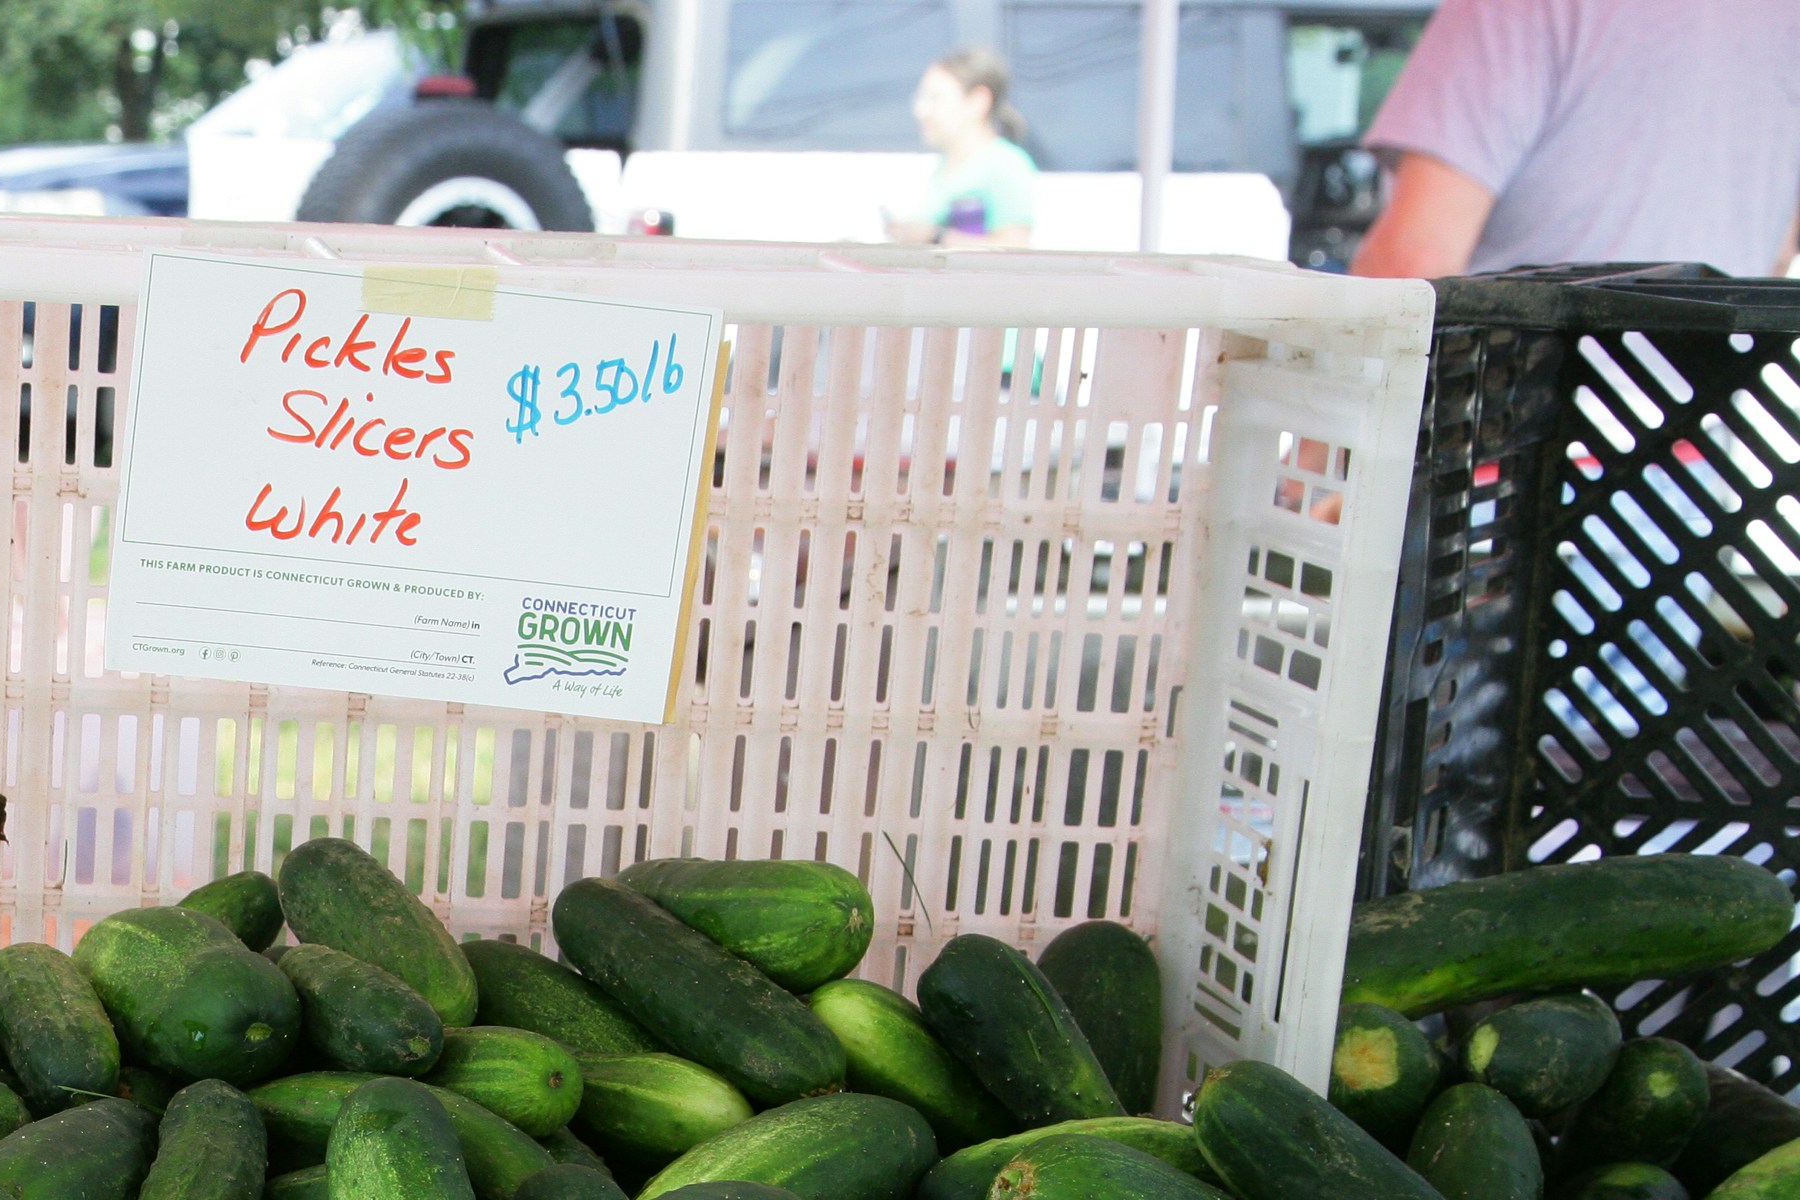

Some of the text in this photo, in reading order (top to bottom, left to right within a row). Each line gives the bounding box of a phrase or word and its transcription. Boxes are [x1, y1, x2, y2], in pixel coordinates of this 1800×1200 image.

[240, 288, 456, 384] Pickles
[267, 389, 474, 470] Slicers
[140, 558, 485, 601] THIS FARM PRODUCT IS CONNECTICUT GROWN & PRODUCED BY:
[522, 597, 637, 621] CONNECTICUT
[414, 614, 439, 626] (Farm
[440, 617, 471, 630] Name)
[517, 611, 633, 652] GROWN
[132, 643, 185, 656] CTGrown.org
[410, 649, 475, 664] (City/Town) CT.
[311, 658, 347, 670] Reference:
[348, 662, 388, 673] Connecticut
[389, 667, 416, 677] General
[417, 669, 445, 680] Statutes
[552, 679, 623, 699] A Way of Life
